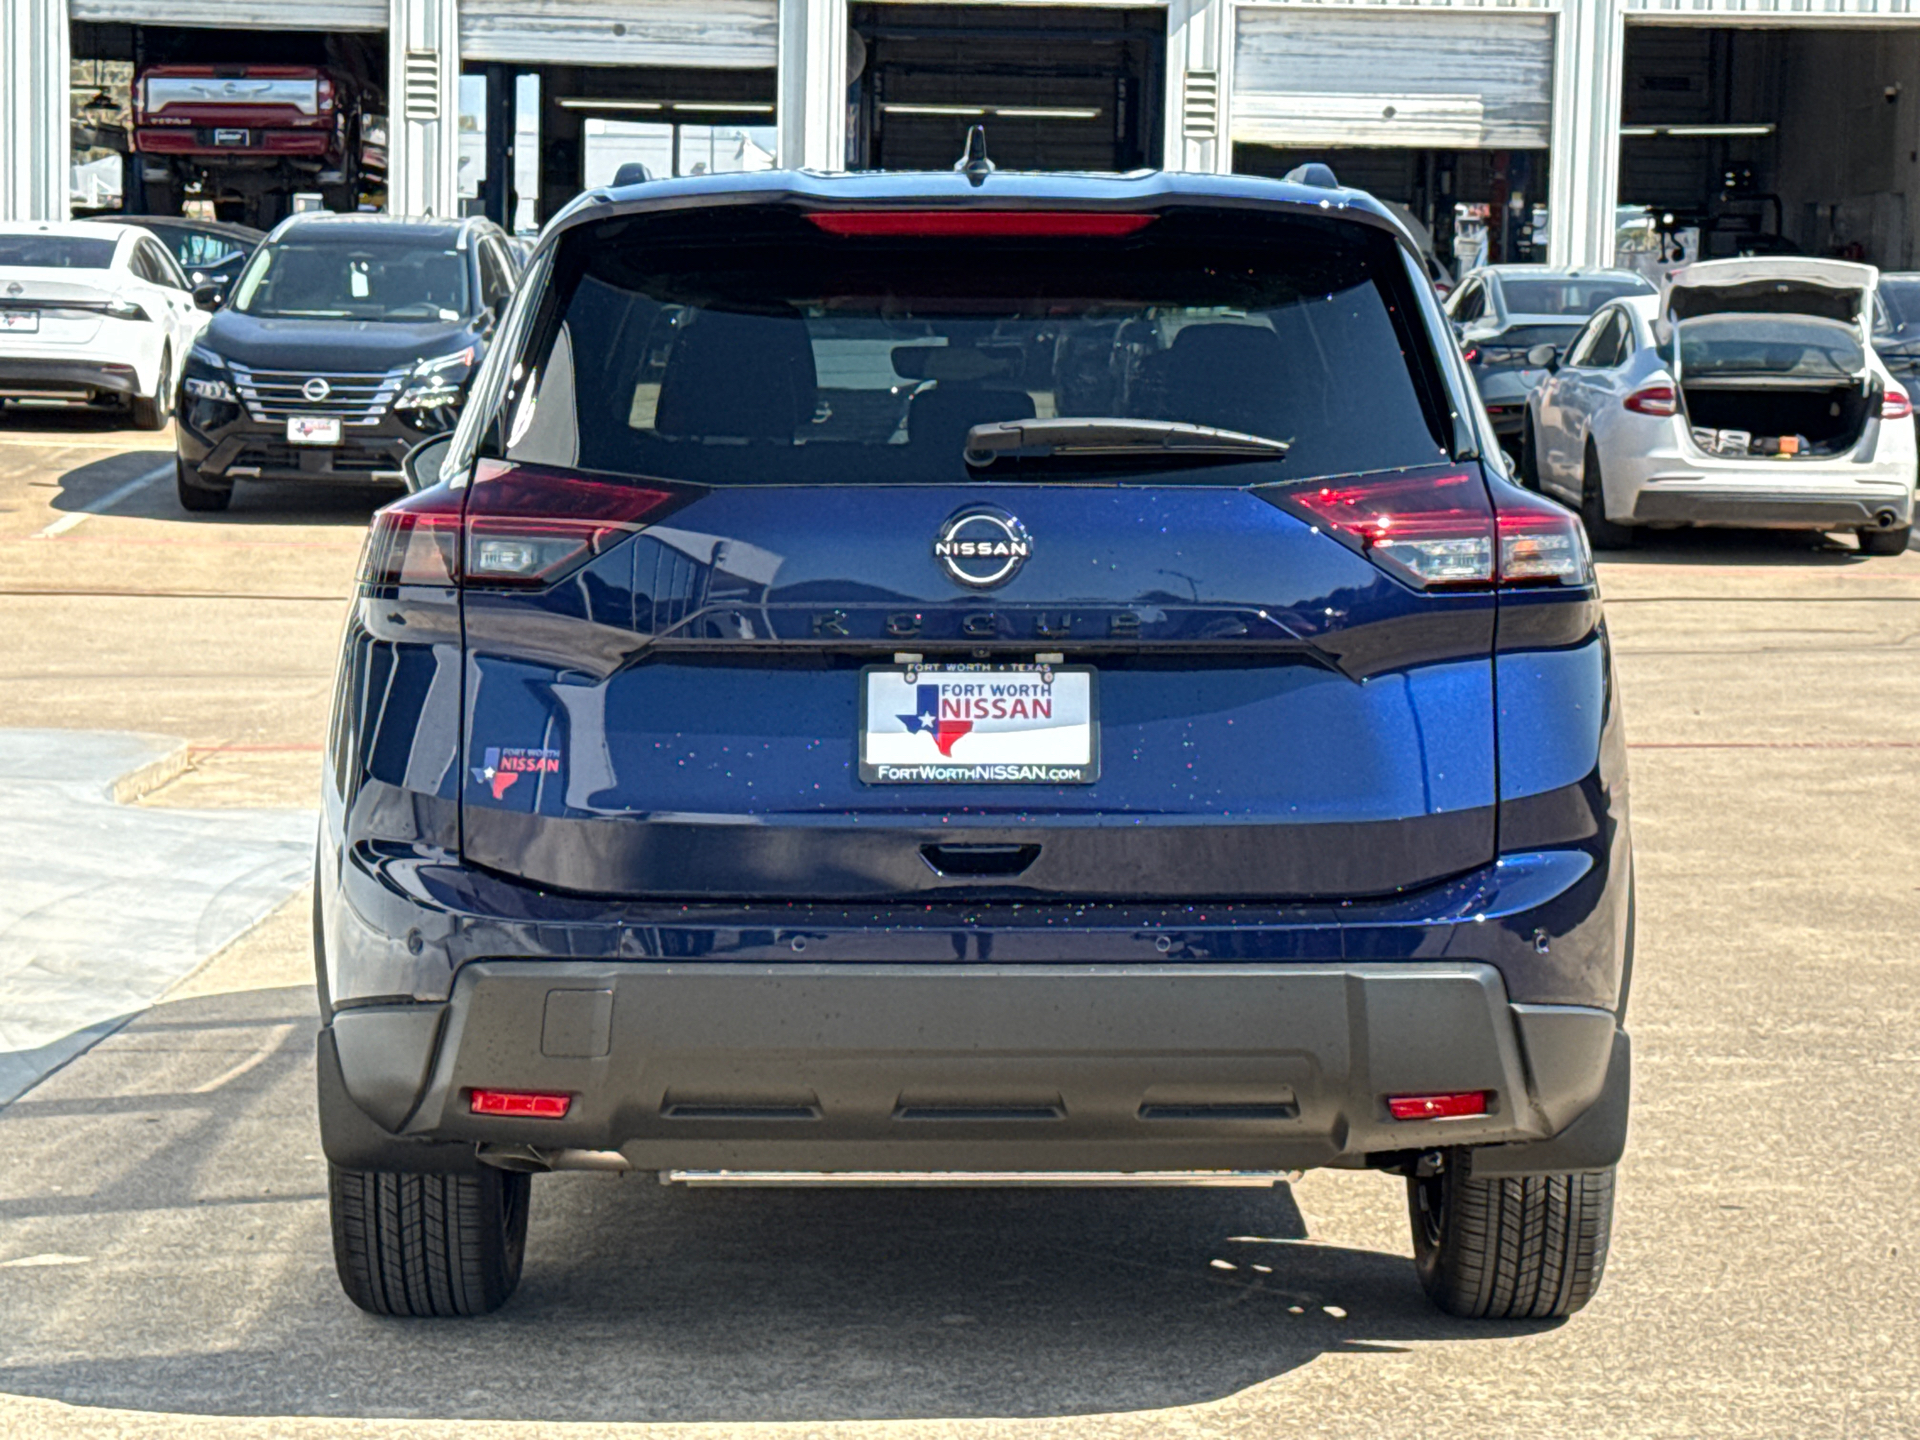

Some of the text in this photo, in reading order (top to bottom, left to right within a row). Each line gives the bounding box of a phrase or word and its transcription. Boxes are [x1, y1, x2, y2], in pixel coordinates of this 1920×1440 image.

[935, 542, 1027, 556] NISSAN
[907, 663, 1051, 673] FORT WORTH TEXAS
[941, 684, 1052, 697] FORT WORTH
[941, 698, 1052, 719] NISSAN
[501, 756, 560, 772] NISSAN
